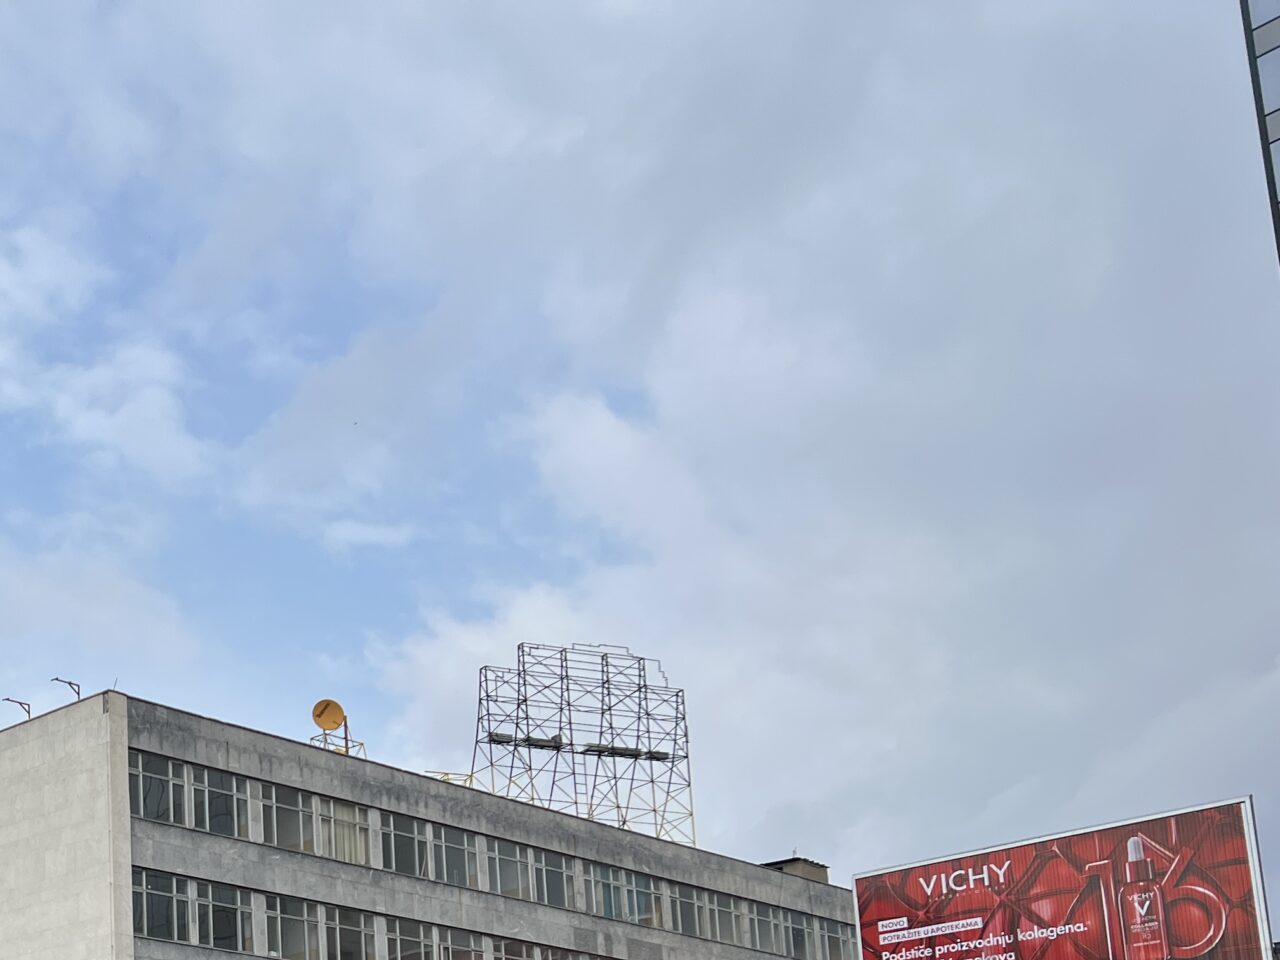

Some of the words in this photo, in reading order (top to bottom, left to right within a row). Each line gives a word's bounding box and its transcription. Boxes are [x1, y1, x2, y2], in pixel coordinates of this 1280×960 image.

[918, 860, 1012, 896] VICHY
[880, 919, 906, 930] NOVO
[882, 930, 921, 943] POTRAŽITE
[930, 920, 979, 934] APOTEKAMA
[935, 934, 1014, 958] proizvodnju
